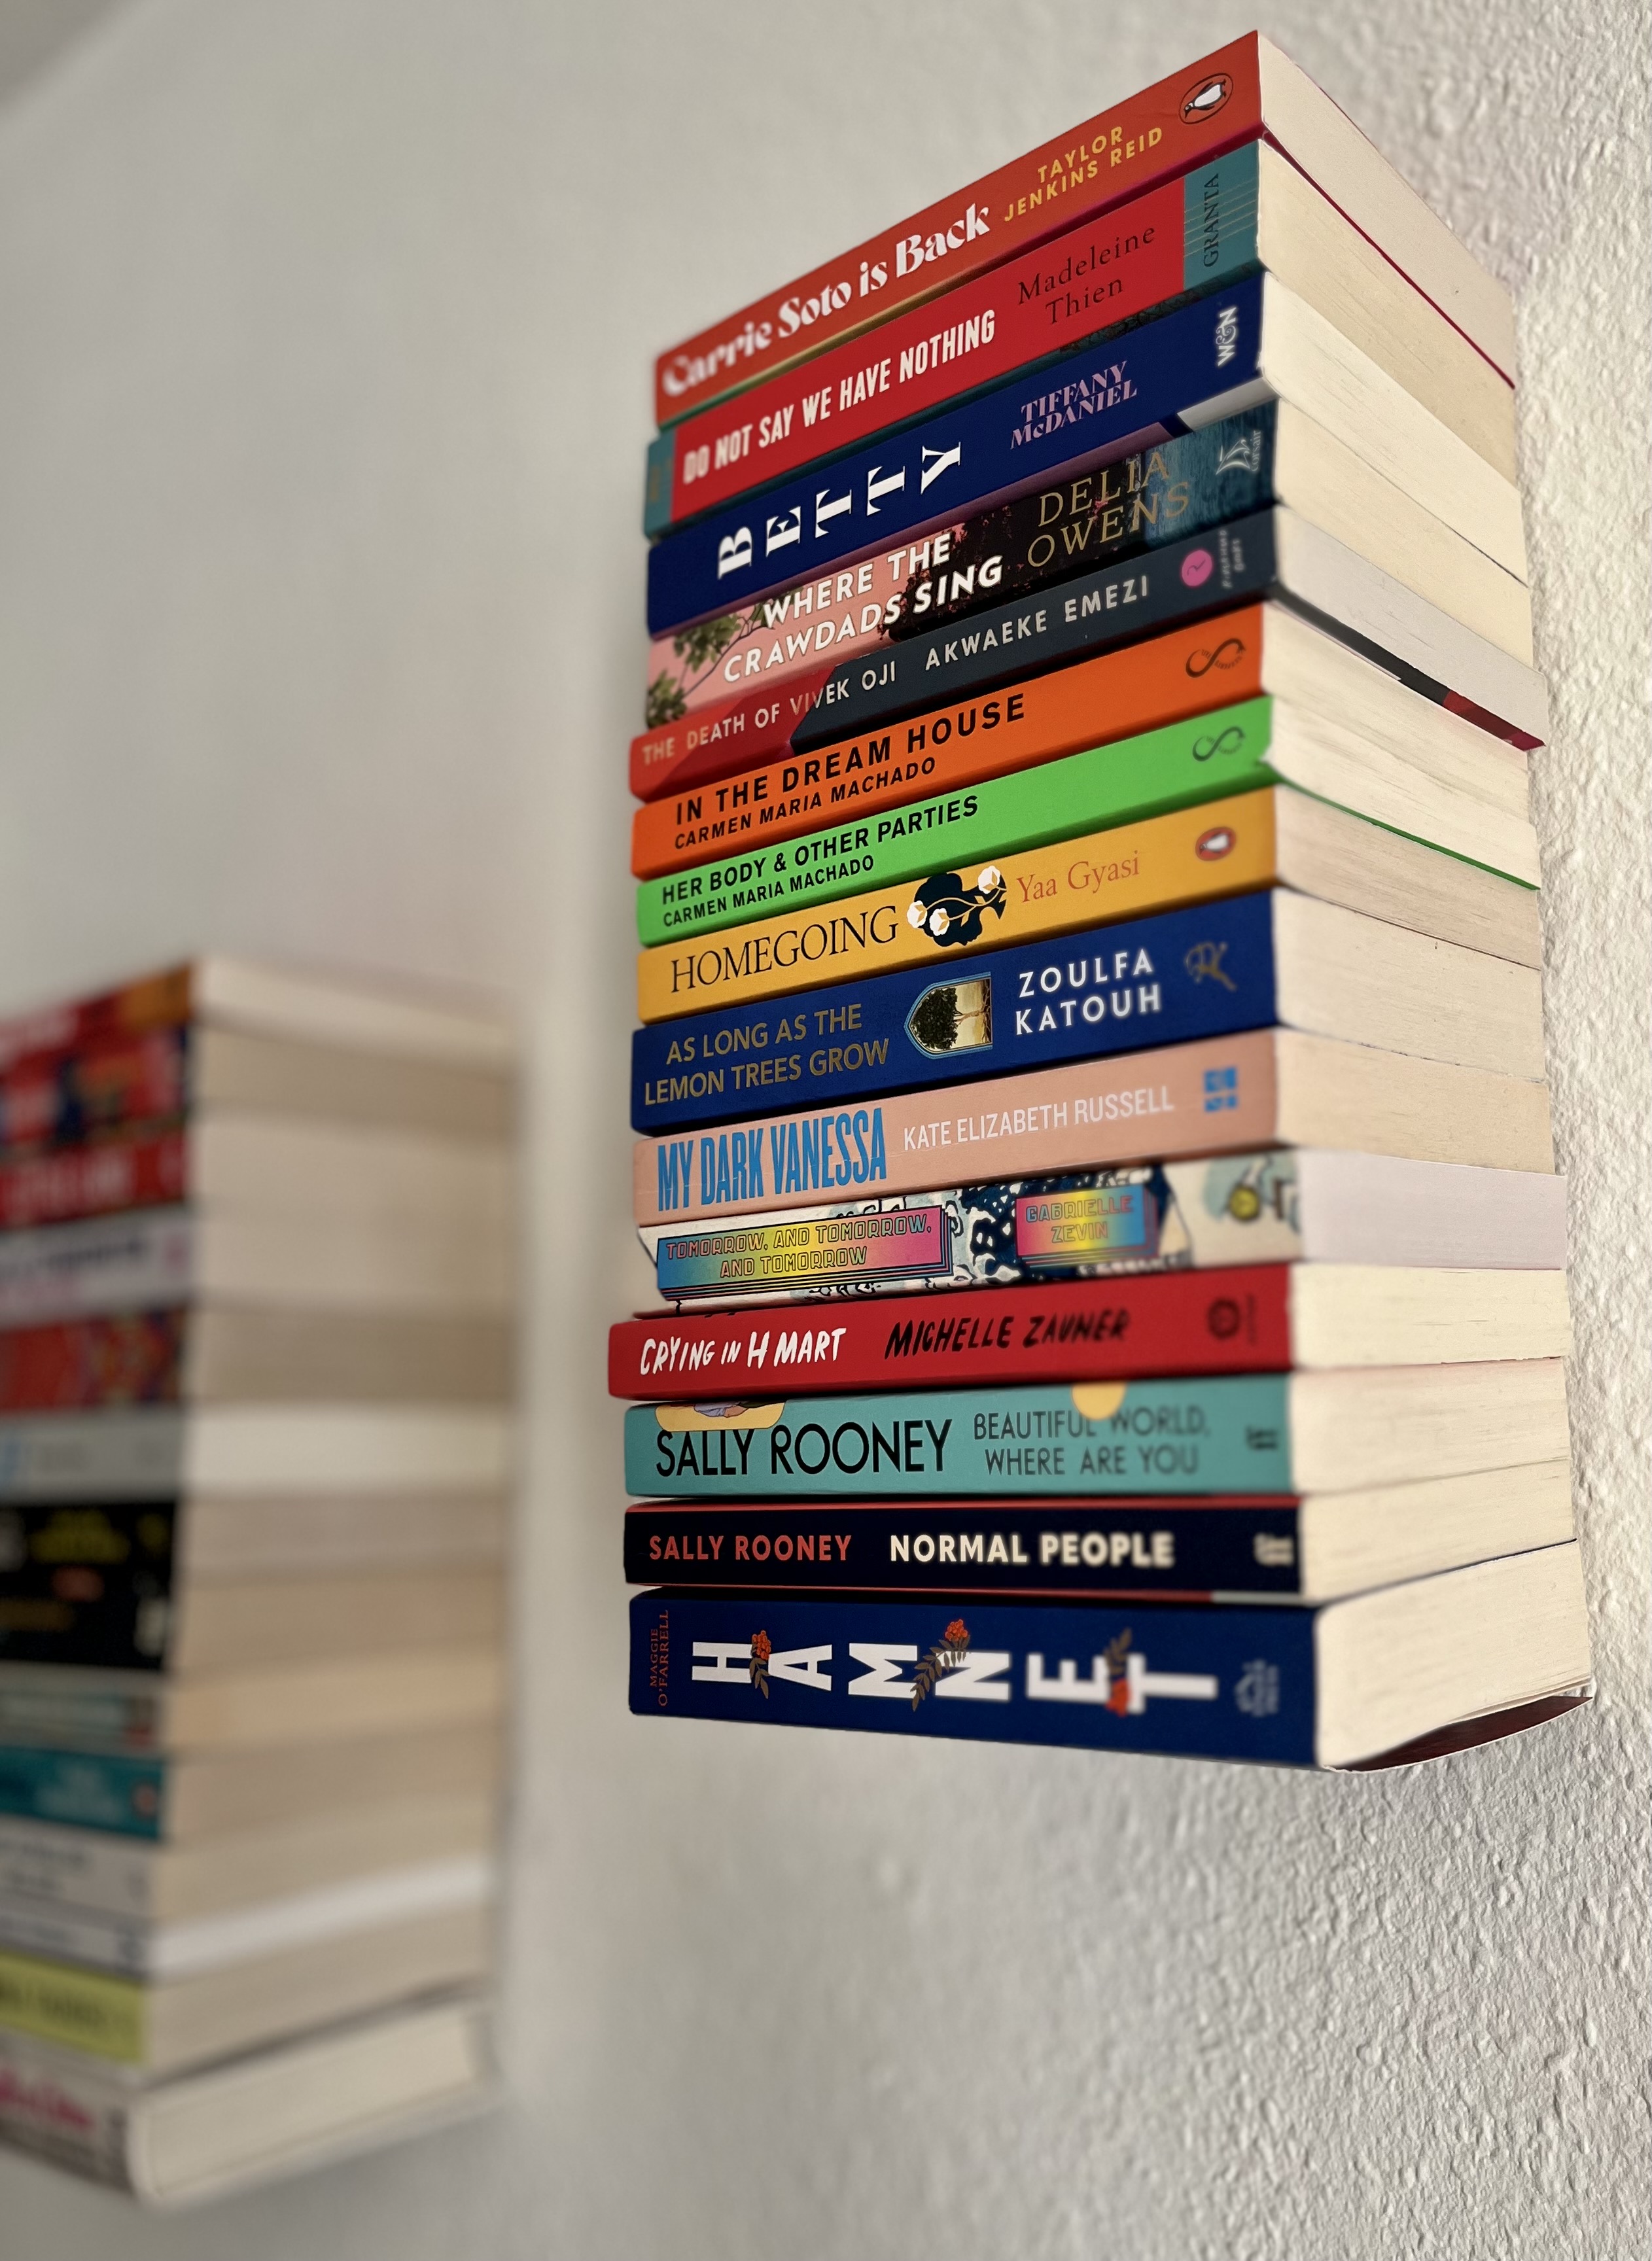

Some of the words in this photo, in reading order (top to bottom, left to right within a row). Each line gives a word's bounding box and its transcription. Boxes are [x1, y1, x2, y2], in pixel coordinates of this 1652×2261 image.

[1004, 160, 1098, 222] JENKINS
[1110, 128, 1163, 169] REID
[1038, 126, 1123, 184] TAYLOR
[1203, 173, 1220, 267] GRANTA
[663, 321, 773, 396] Carrie
[779, 282, 852, 338] Soto
[859, 261, 888, 297] is
[896, 203, 990, 278] Back
[1018, 227, 1156, 305] Madeleine
[1045, 277, 1123, 326] Thien
[683, 445, 709, 484] DO
[715, 424, 753, 469] NOT
[758, 404, 794, 447] SAY
[802, 387, 832, 427] WE
[839, 359, 892, 411] HAVE
[899, 309, 995, 383] NOTHING
[1010, 379, 1138, 449] McDANIEL
[1021, 360, 1127, 424] TIFFANY
[1250, 430, 1261, 472] corsair
[718, 442, 961, 579] BETTY
[1039, 451, 1169, 527] DELIA
[1027, 482, 1191, 568] OWENS
[763, 563, 873, 629] WHERE
[887, 533, 953, 581] THE
[724, 594, 902, 683] CRAWDADS
[913, 555, 1004, 615] SING
[924, 609, 1047, 671] AKWAEKE
[1064, 575, 1148, 623] EMEZI
[642, 737, 675, 765] THE
[687, 714, 745, 750] DEATH
[754, 703, 780, 729] OF
[790, 678, 849, 716] VIVEK
[862, 661, 896, 690] OJI
[676, 796, 702, 826] IN
[716, 776, 769, 813] THE
[782, 736, 891, 794] DREAM
[907, 693, 1025, 754] HOUSE
[675, 813, 752, 850] CARMEN
[759, 792, 822, 826] MARIA
[830, 757, 936, 804] MACHADO
[662, 876, 702, 905] HER
[710, 857, 767, 892] BODY
[773, 852, 787, 873] &
[794, 829, 869, 866] OTHER
[877, 796, 978, 843] PARTIES
[1016, 874, 1058, 903] Yaa
[1067, 850, 1140, 896] Gyasi
[663, 897, 727, 927] CARMEN
[733, 882, 784, 908] MARIA
[790, 855, 874, 892] MACHADO
[671, 905, 900, 993] HOMEGOING
[1019, 948, 1153, 998] ZOULFA
[666, 1038, 695, 1065] AS
[703, 1023, 769, 1058] LONG
[775, 1015, 807, 1043] AS
[814, 1003, 862, 1035] THE
[1015, 984, 1161, 1036] KATOUH
[644, 1069, 725, 1105] LEMON
[731, 1055, 802, 1090] TREES
[809, 1038, 890, 1074] GROW
[904, 1125, 951, 1150] KATE
[957, 1103, 1068, 1143] ELIZABETH
[1074, 1085, 1175, 1125] RUSSELL
[658, 1140, 694, 1212] MY
[701, 1128, 764, 1206] DARK
[771, 1107, 887, 1194] VANESSA
[666, 1233, 768, 1259] TOMORROW,
[773, 1227, 810, 1248] AND
[815, 1214, 932, 1243] TOMORROW,
[1025, 1195, 1134, 1222] GABRIELLE
[1050, 1221, 1109, 1243] ZEVIN
[720, 1257, 754, 1278] AND
[760, 1246, 867, 1274] TOMORROW
[640, 1337, 715, 1375] CRYING
[721, 1341, 741, 1364] IN
[747, 1331, 770, 1368] H
[773, 1327, 847, 1366] MART
[884, 1315, 1015, 1359] MICHELLE
[1022, 1308, 1130, 1348] ZAUNER
[656, 1429, 755, 1477] SALLY
[771, 1419, 953, 1475] ROONEY
[974, 1411, 1097, 1440] BEAUTIFUL
[985, 1447, 1065, 1475] WHERE
[1080, 1446, 1126, 1474] ARE
[1138, 1445, 1199, 1474] YOU
[650, 1535, 724, 1561] SALLY
[735, 1535, 851, 1561] ROONEY
[890, 1534, 1028, 1562] NORMAL
[1040, 1532, 1174, 1568] PEOPLE
[650, 1629, 659, 1687] MAGGIE
[658, 1609, 670, 1707] O'FARRELL
[692, 1642, 1218, 1715] HAMNET
